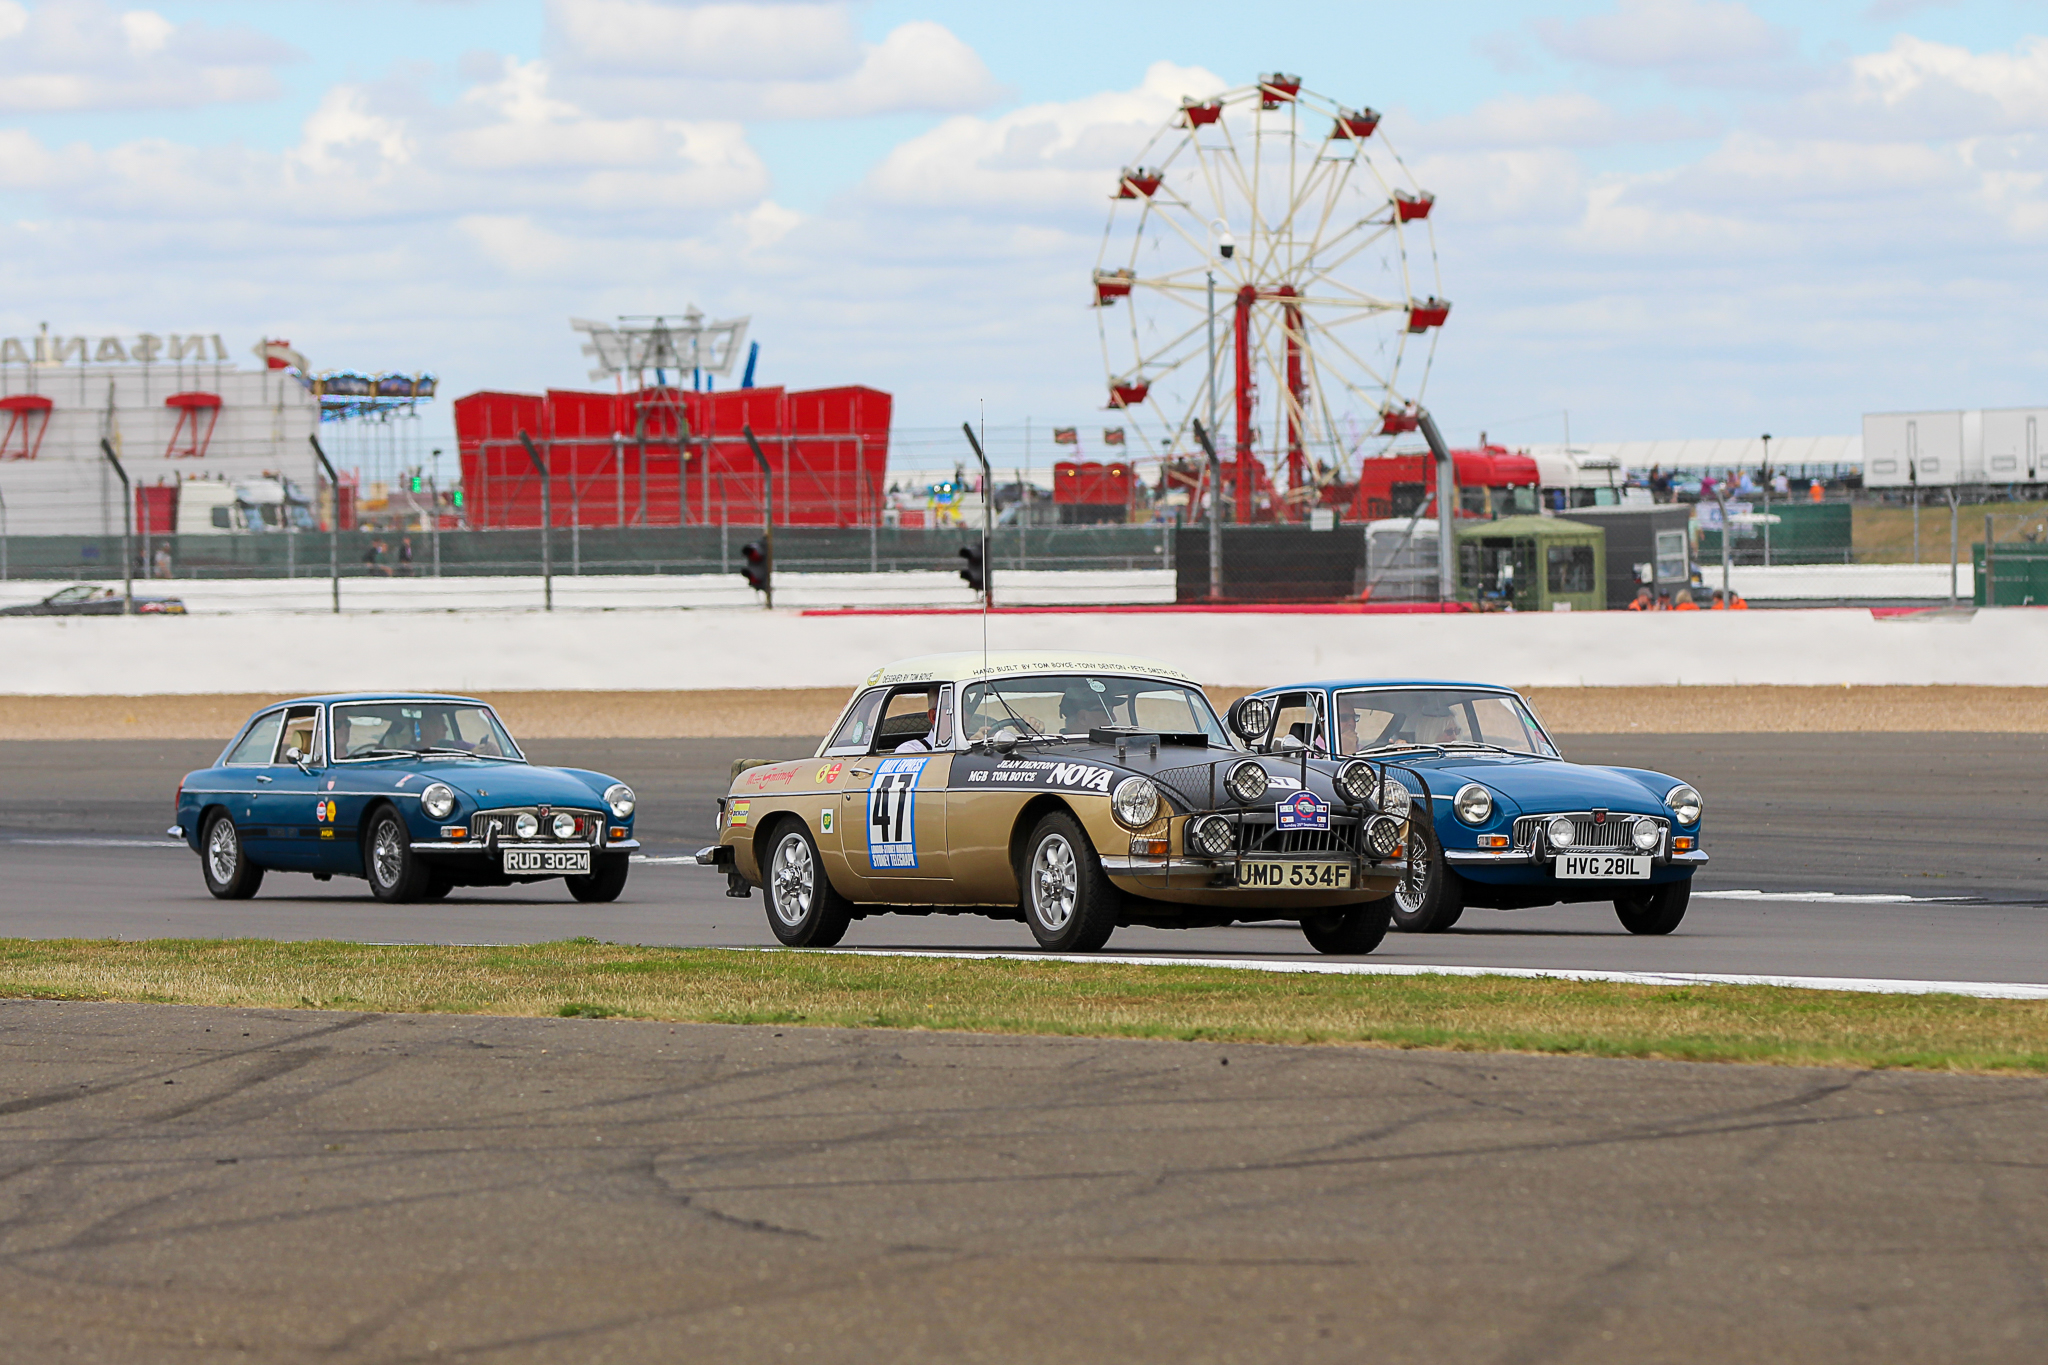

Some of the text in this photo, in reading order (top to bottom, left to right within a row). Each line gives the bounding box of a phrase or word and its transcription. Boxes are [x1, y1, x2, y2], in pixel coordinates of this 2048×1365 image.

[973, 667, 994, 675] HAND
[997, 664, 1018, 672] BUILT
[1098, 663, 1126, 671] DENTON
[1131, 664, 1147, 673] PETE
[997, 759, 1058, 770] JEAN DENTON
[968, 770, 1037, 782] MGB TOM BOYCE
[1046, 762, 1114, 792] NOVA
[873, 774, 913, 842] 47
[507, 853, 587, 870] RUD 302M
[1566, 857, 1639, 876] HVG 281L
[1239, 863, 1350, 887] UMD 534F
